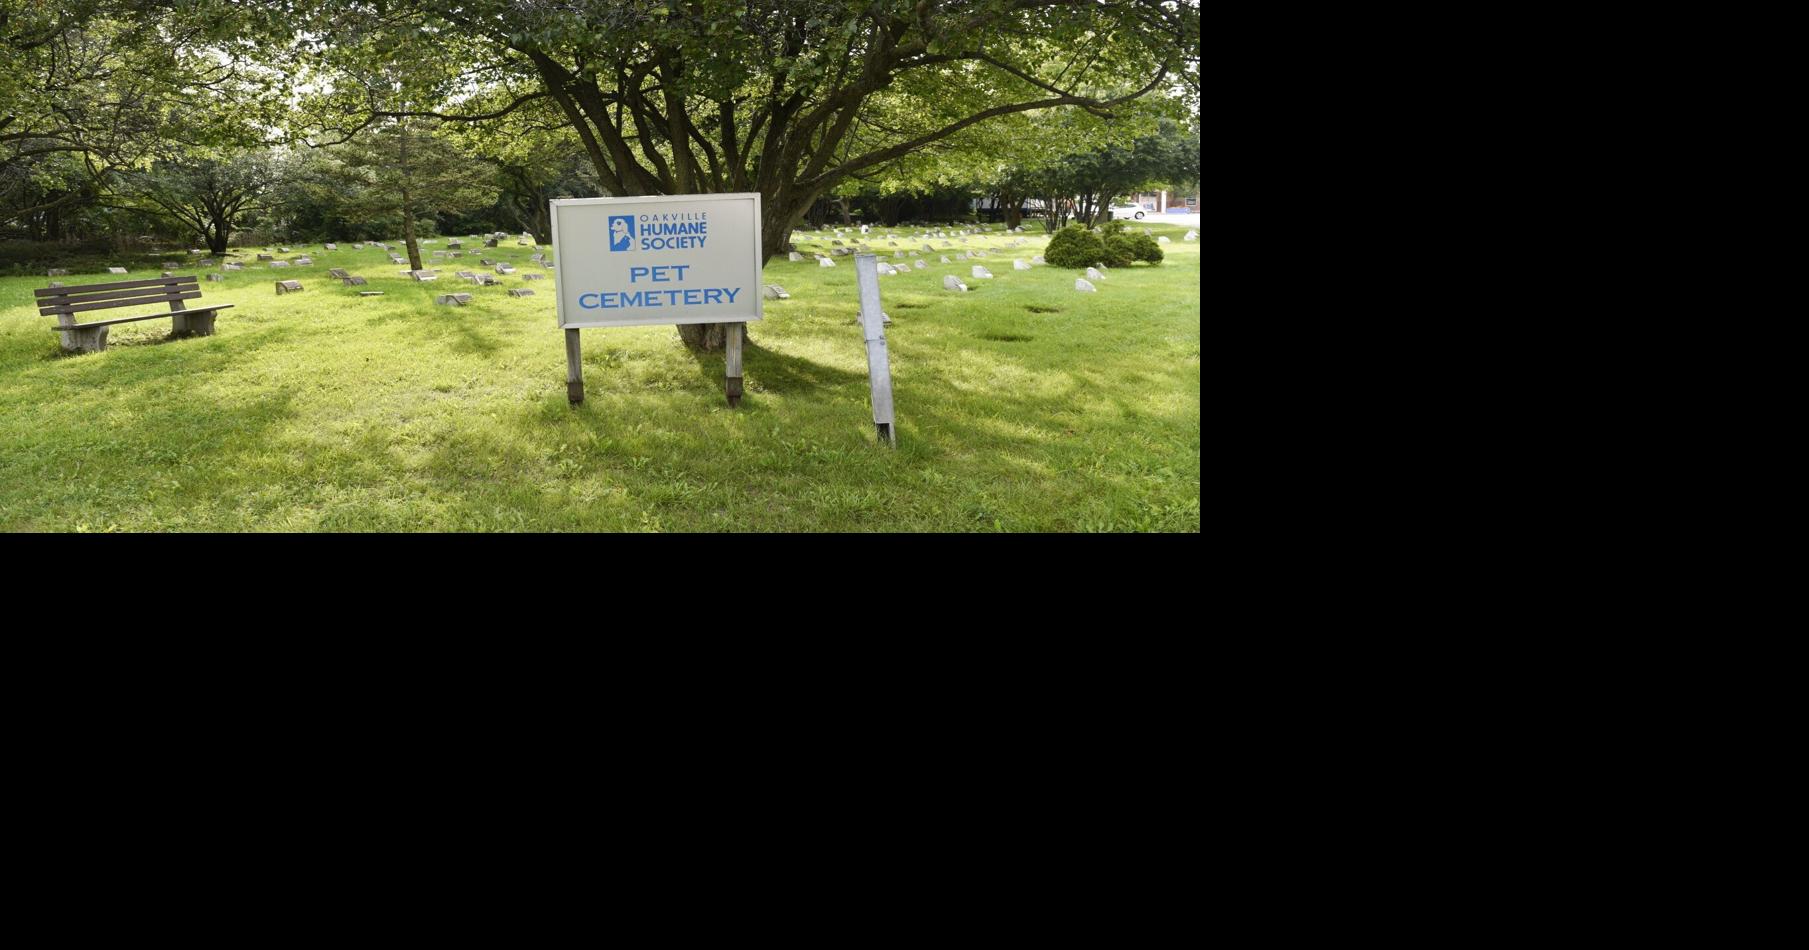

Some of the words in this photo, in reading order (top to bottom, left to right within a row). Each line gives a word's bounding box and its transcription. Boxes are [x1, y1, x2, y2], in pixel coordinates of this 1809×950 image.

[640, 212, 707, 222] OAKVILLE
[640, 222, 707, 236] HUMANE
[641, 236, 707, 250] SOCIETY
[630, 265, 690, 283] PET
[578, 287, 741, 309] CEMETERY
